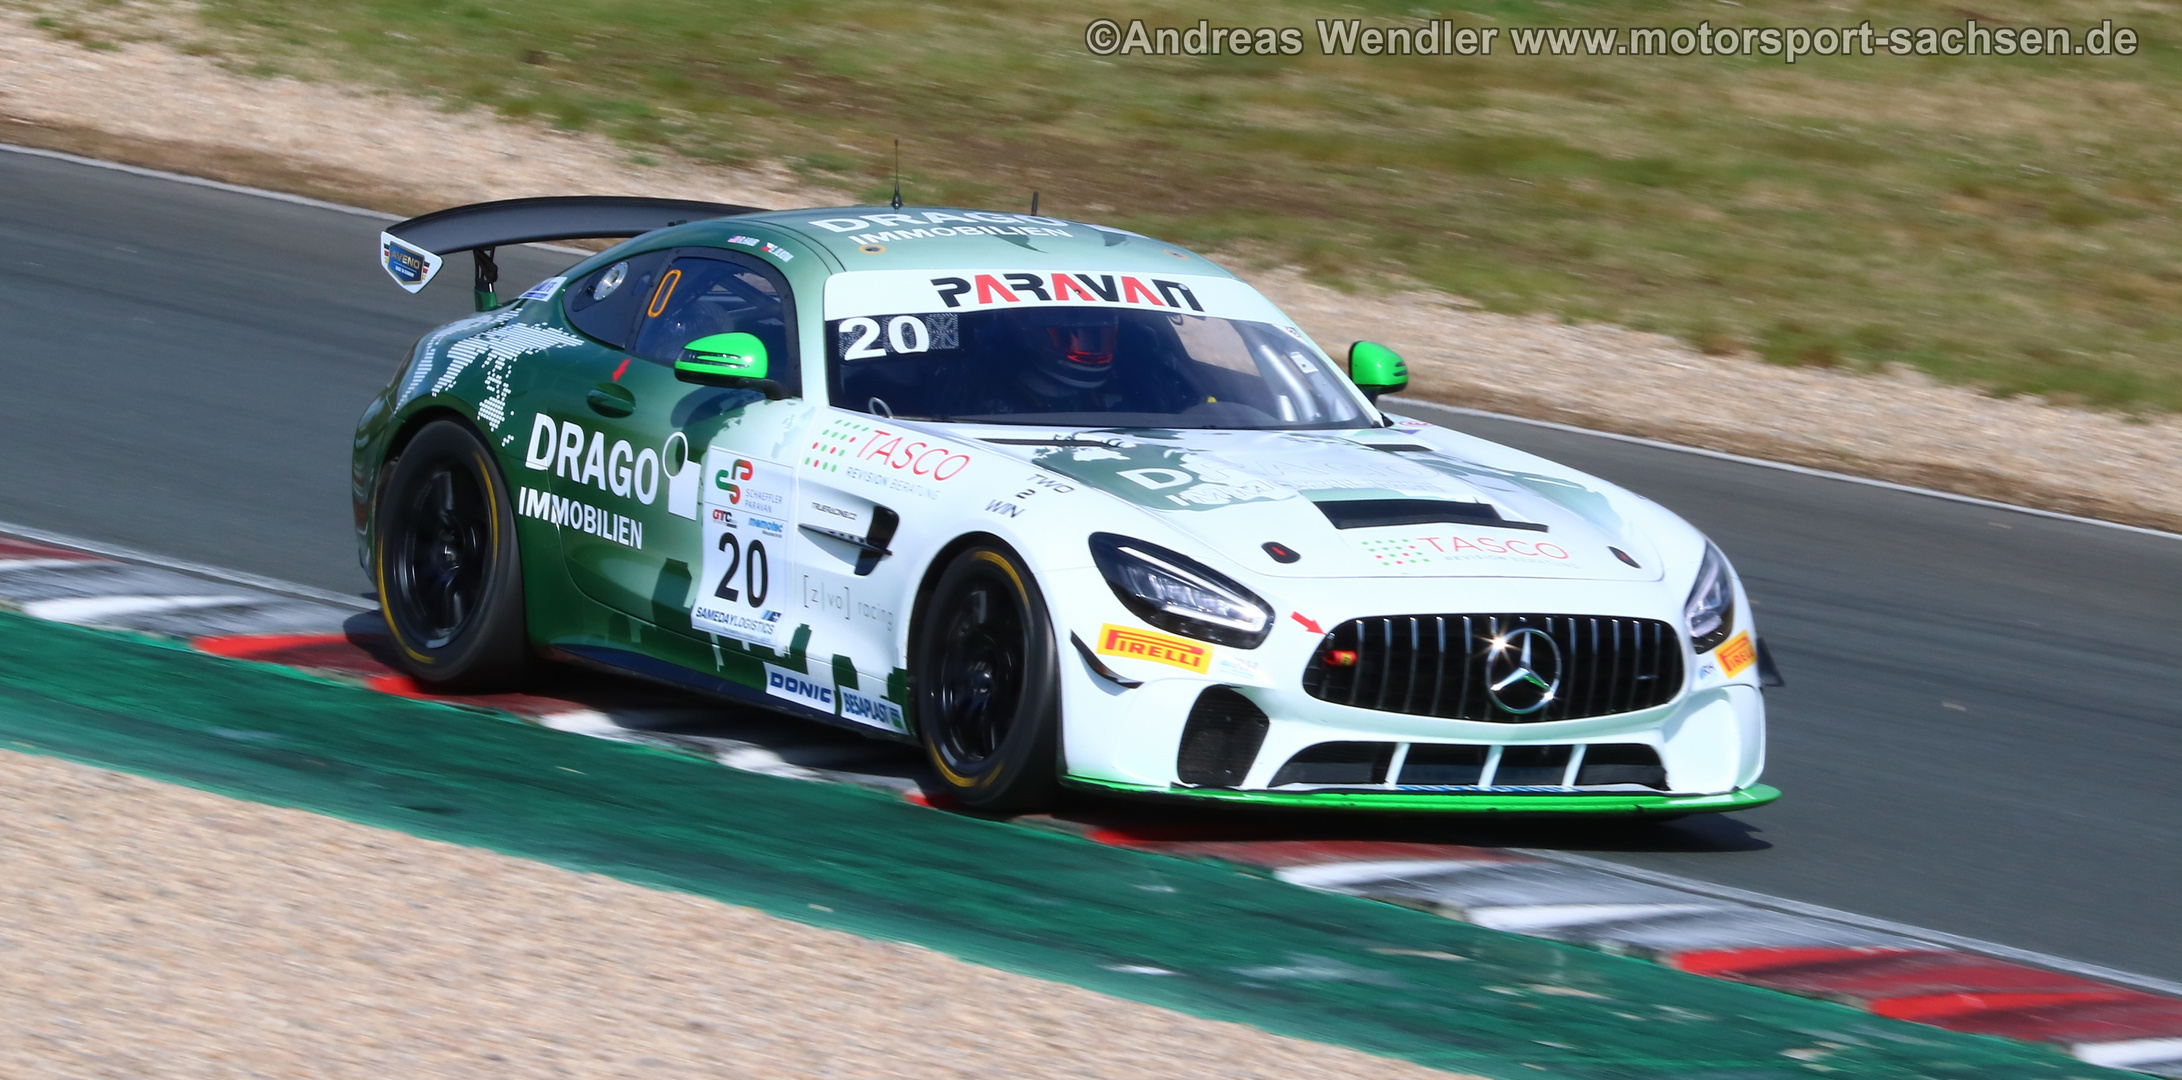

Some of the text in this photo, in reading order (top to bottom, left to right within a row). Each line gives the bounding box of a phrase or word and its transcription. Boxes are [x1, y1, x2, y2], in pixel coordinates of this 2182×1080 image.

[808, 211, 1070, 233] DRAGO
[848, 226, 1074, 246] IMMOBILIEN
[391, 250, 420, 270] AVENO
[930, 273, 1205, 312] PARAVAN
[838, 315, 930, 361] 20
[525, 412, 660, 506] DRAGO
[857, 429, 971, 481] TASCO
[745, 488, 783, 505] SCHAEFFLER
[1014, 488, 1037, 500] 2
[1026, 473, 1076, 494] TWO
[518, 486, 643, 550] IMMOBILIEN
[984, 499, 1026, 519] WIN
[1416, 536, 1570, 560] TASCO
[714, 532, 769, 609] 20
[1105, 629, 1205, 668] PIRELLI
[770, 671, 833, 704] DONIC
